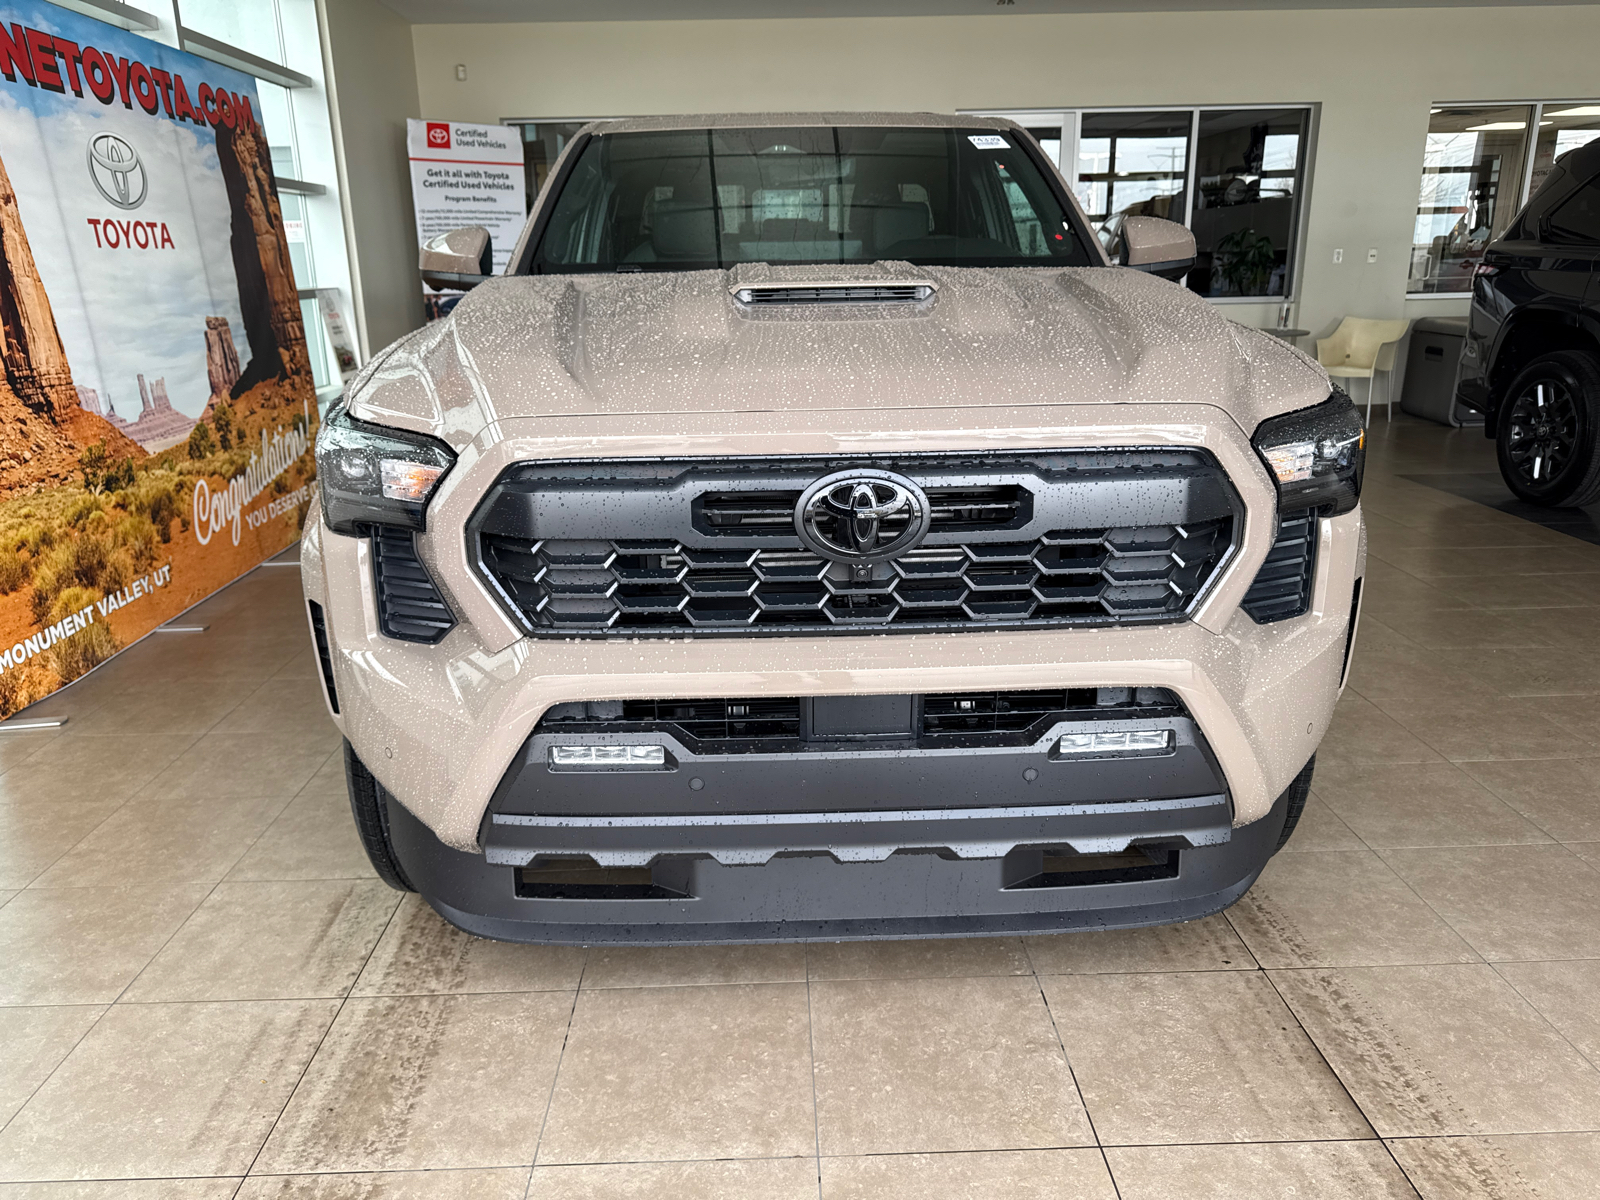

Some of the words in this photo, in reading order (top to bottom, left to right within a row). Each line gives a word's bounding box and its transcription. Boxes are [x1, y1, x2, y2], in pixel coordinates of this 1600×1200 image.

[455, 128, 488, 138] Certified
[456, 139, 476, 147] Used
[476, 140, 507, 149] Vehicles
[427, 169, 443, 178] Get
[444, 169, 451, 178] it
[452, 170, 463, 178] all
[464, 170, 482, 179] with
[483, 171, 510, 181] Toyota
[423, 180, 459, 189] Certified
[460, 180, 481, 190] Used
[482, 182, 515, 191] Vehicles
[444, 195, 471, 203] Program
[472, 195, 497, 203] Benefits
[87, 218, 175, 250] TOYOTA
[193, 399, 311, 547] Congratulations!
[245, 506, 268, 530] YOU
[268, 485, 310, 519] DESERVE
[0, 605, 95, 675] MONUMENT
[96, 575, 154, 618] VALLEY,
[153, 564, 171, 587] UT
